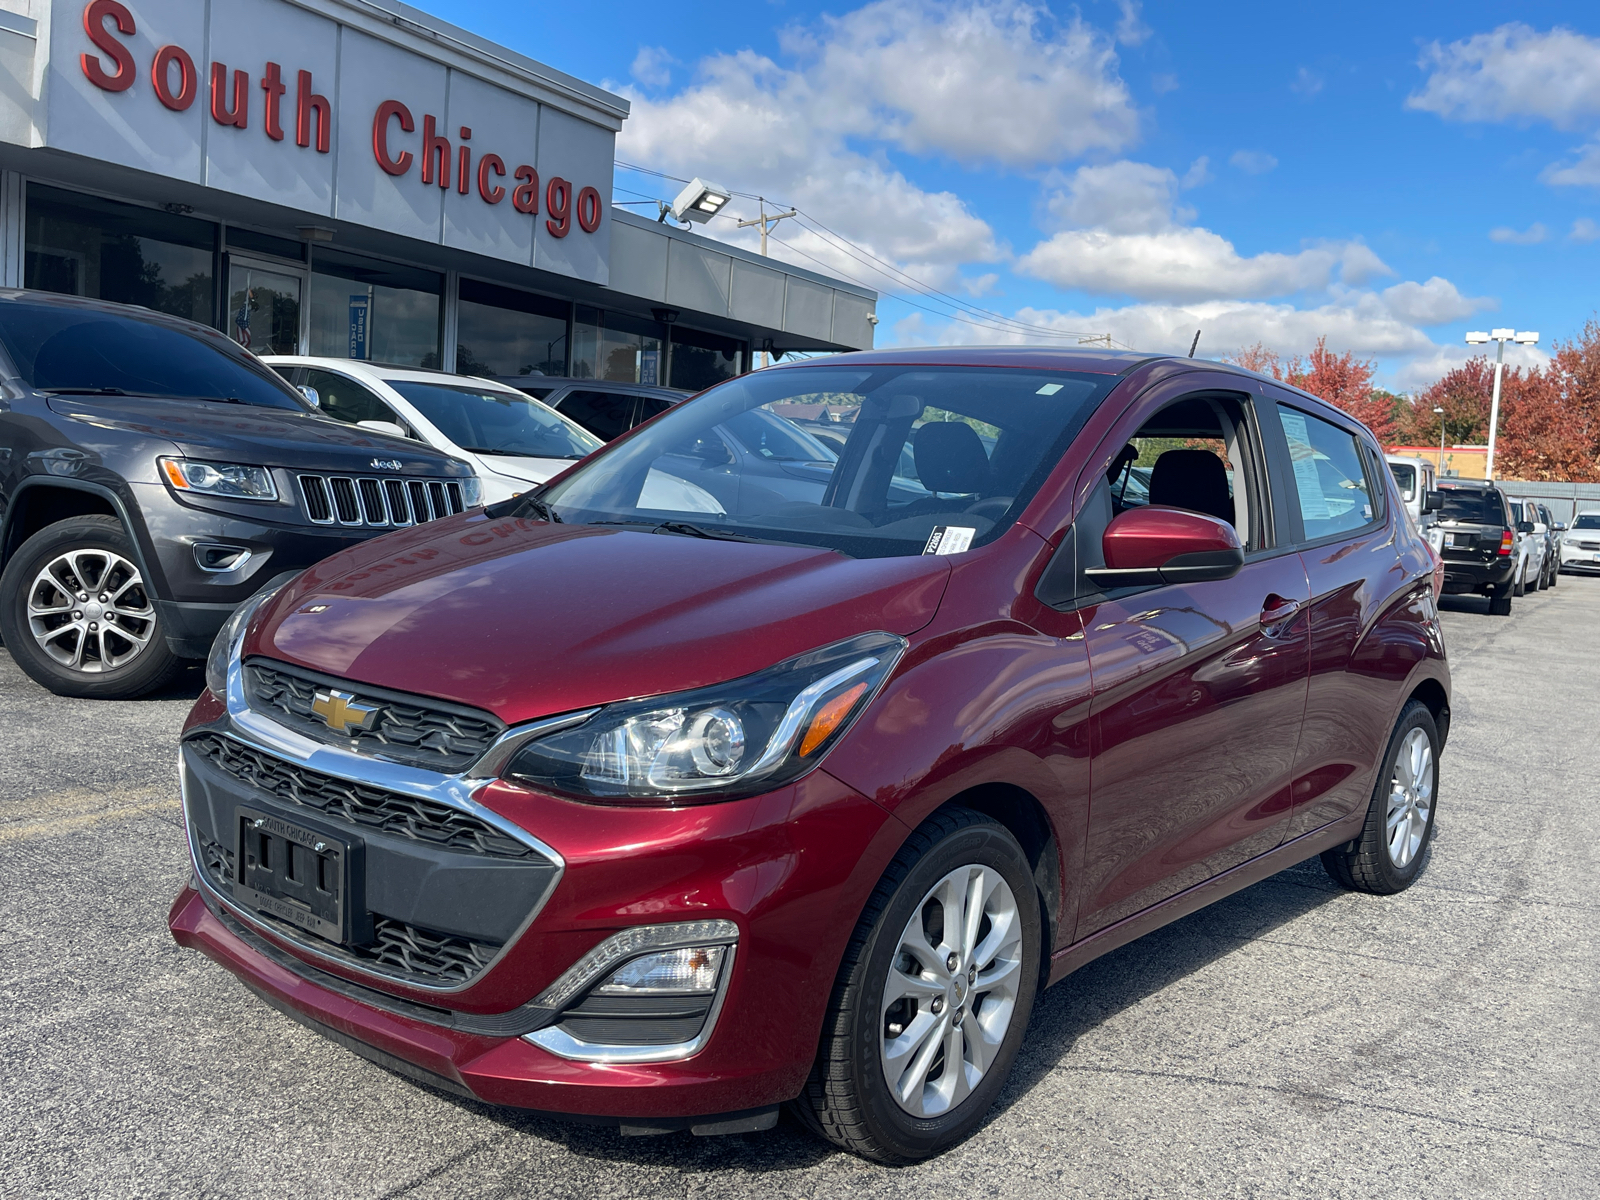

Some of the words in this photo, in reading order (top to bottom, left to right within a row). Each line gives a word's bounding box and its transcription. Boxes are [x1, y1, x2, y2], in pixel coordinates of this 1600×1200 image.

[80, 0, 332, 153] South
[372, 99, 603, 239] Chicago
[370, 457, 403, 471] Jeep
[287, 825, 317, 847] CHICAGO
